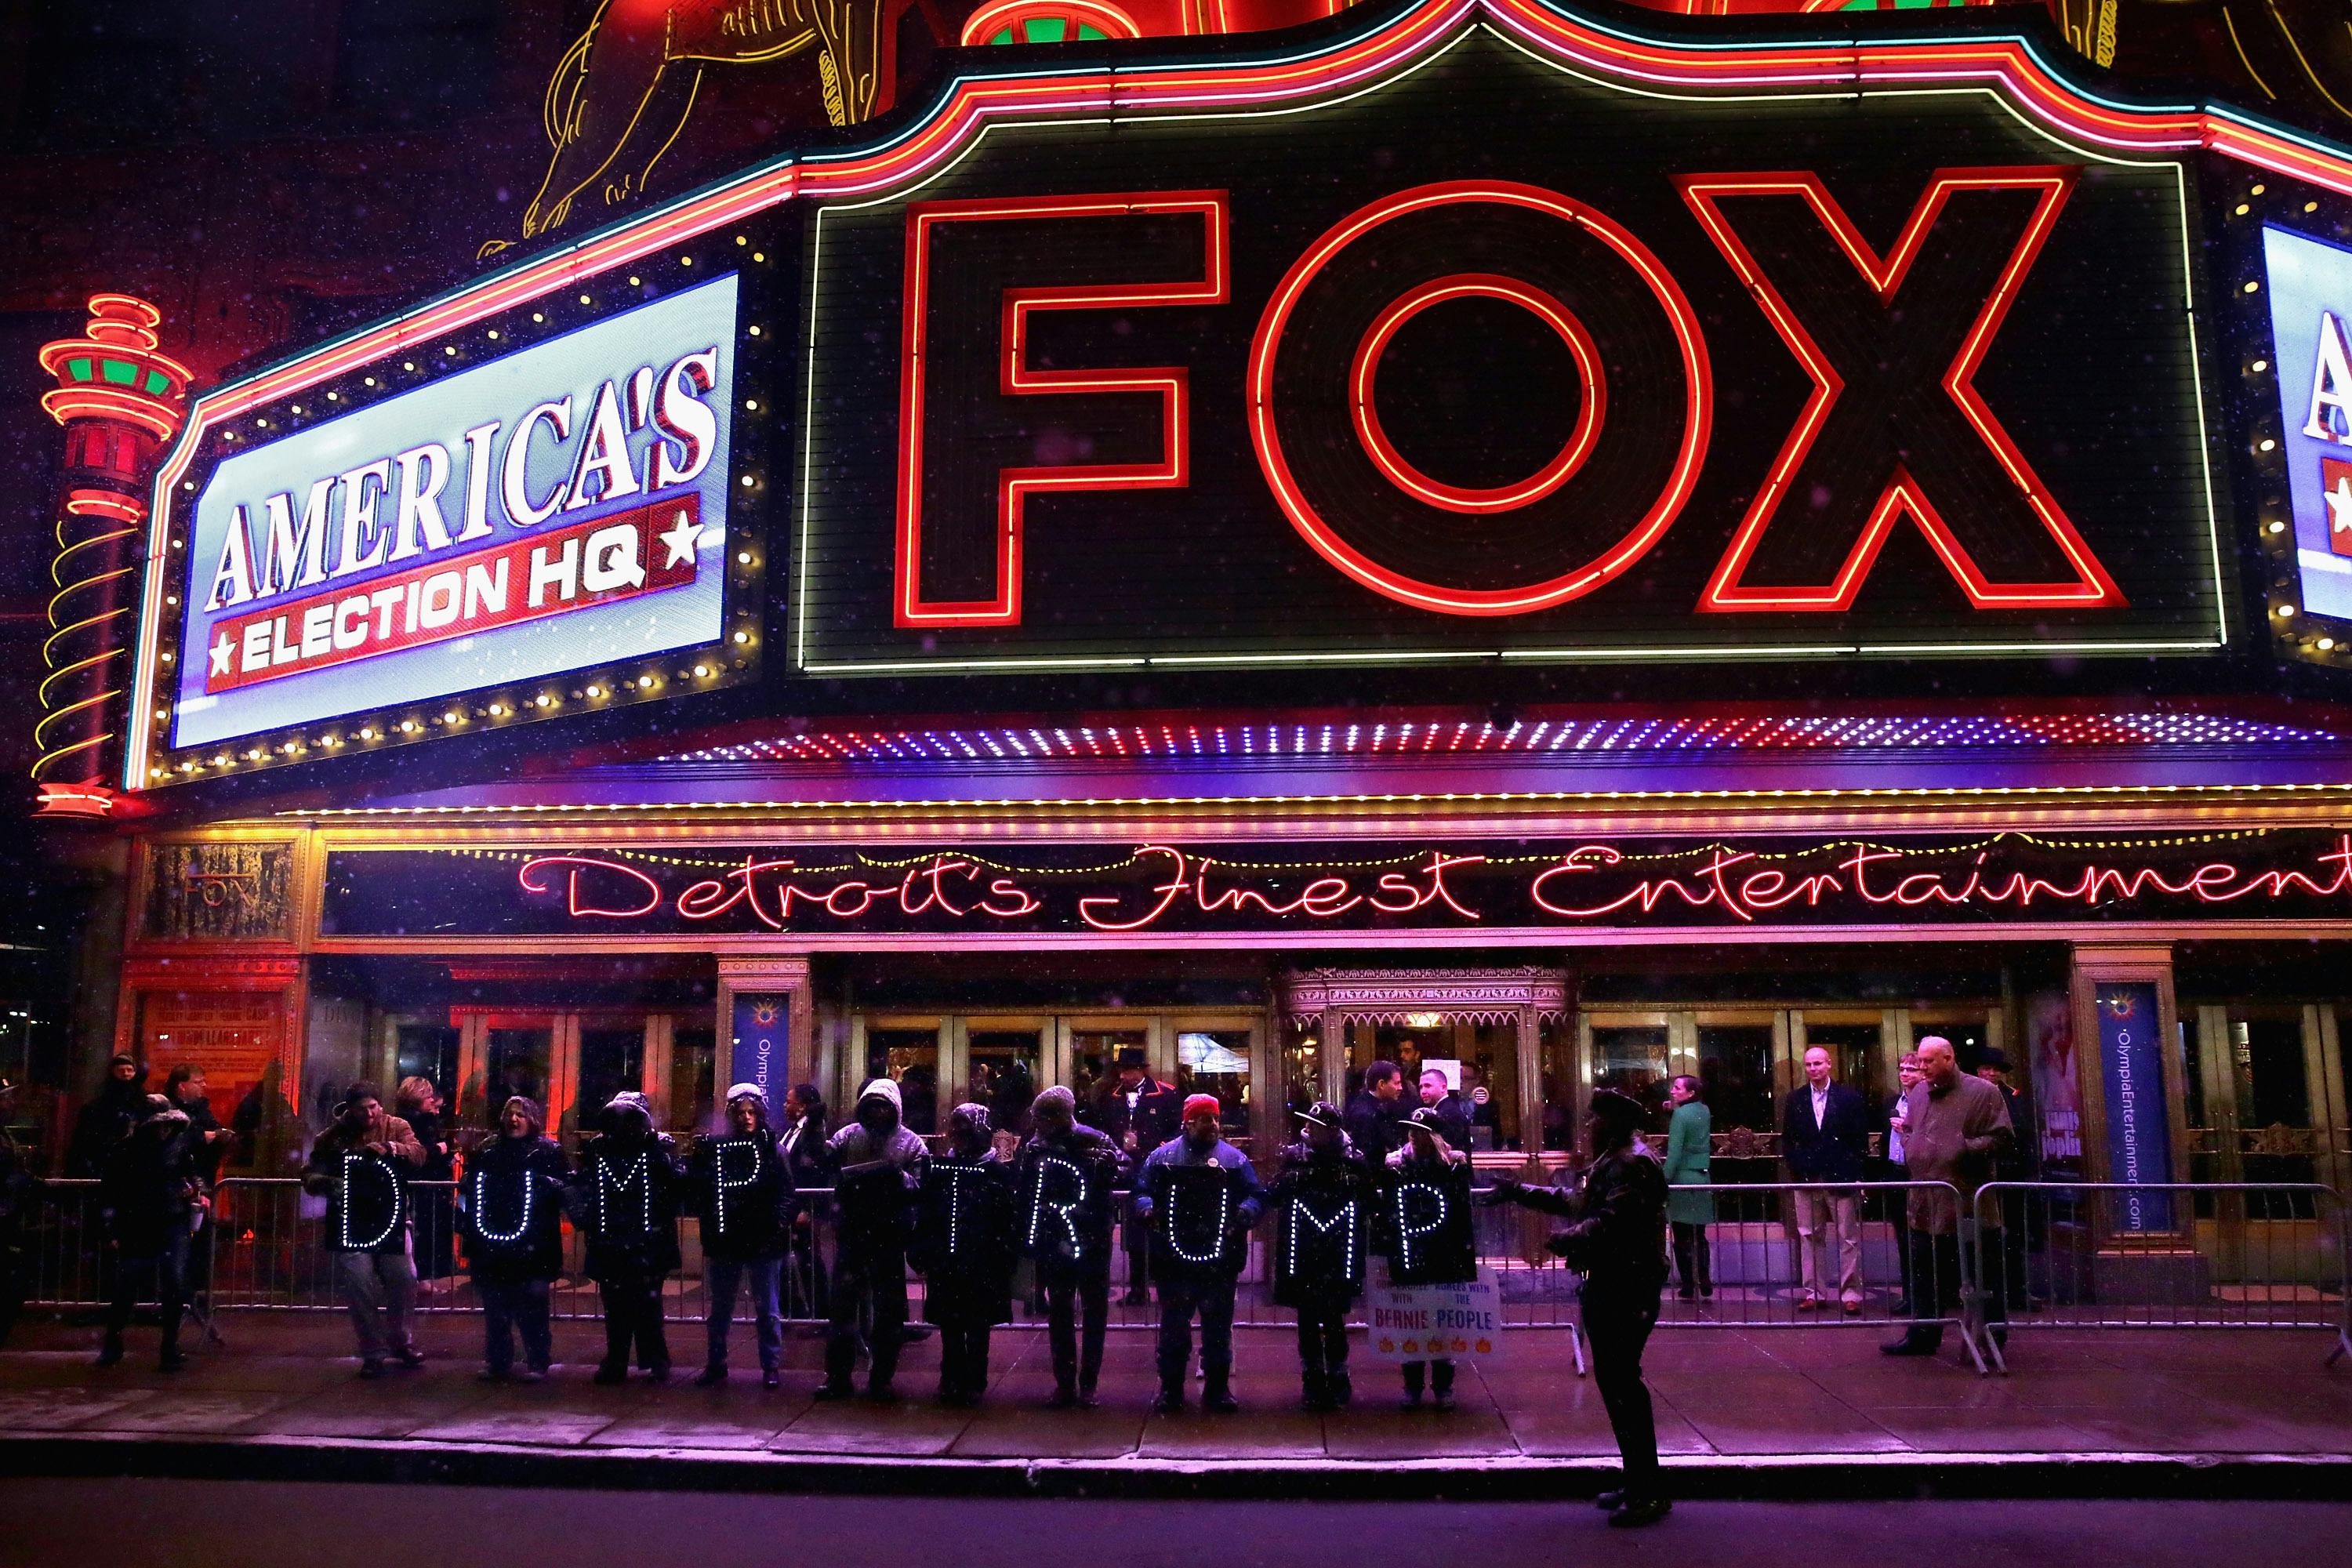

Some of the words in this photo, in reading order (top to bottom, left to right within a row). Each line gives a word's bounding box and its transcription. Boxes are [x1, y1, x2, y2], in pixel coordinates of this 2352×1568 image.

[893, 165, 2129, 629] FOX
[204, 346, 719, 614] AMERICA'S
[241, 556, 510, 674] ELECTION
[527, 523, 646, 607] HQ
[185, 873, 255, 908] FOX
[520, 855, 1040, 929] Detroit's
[1080, 845, 1485, 930] Finest
[1532, 833, 2352, 921] Entertainment
[2118, 1032, 2141, 1229] OlympiaEntertainmen.com
[343, 1141, 760, 1248] DUMP
[930, 1158, 1446, 1279] TRUMP
[1374, 1308, 1429, 1330] BERNIE
[1391, 1293, 1413, 1305] WITH
[1436, 1308, 1493, 1330] PEOPLE
[1454, 1294, 1471, 1305] THE
[1468, 1283, 1490, 1294] WITH
